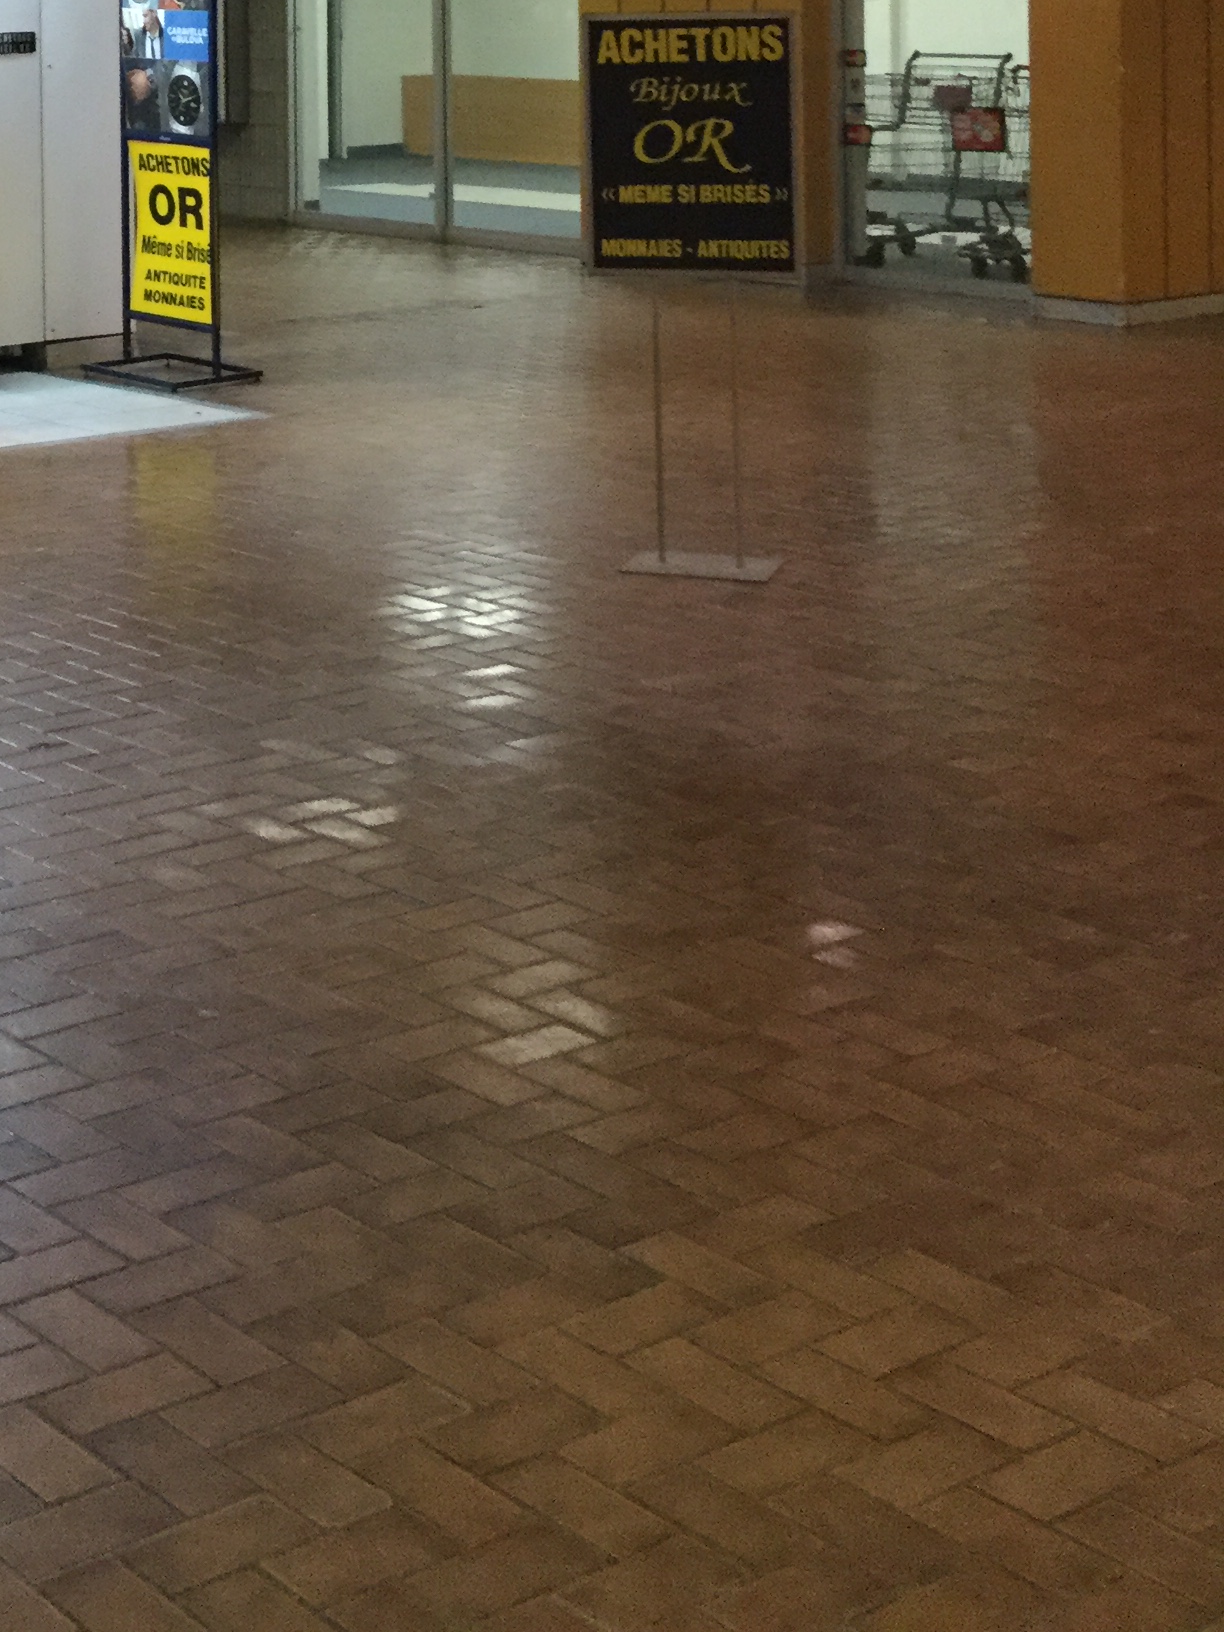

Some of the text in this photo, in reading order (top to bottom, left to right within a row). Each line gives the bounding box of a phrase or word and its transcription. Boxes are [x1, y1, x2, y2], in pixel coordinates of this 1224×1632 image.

[597, 24, 784, 65] ACHETONS
[629, 76, 753, 111] Bijoux
[633, 118, 752, 174] OR
[139, 153, 209, 176] ACHETONS
[149, 183, 203, 230] OR
[678, 184, 696, 204] SI
[141, 234, 172, 258] Même
[175, 240, 184, 259] si
[601, 239, 682, 258] MONNAIES
[143, 288, 206, 311] MONNAIES
